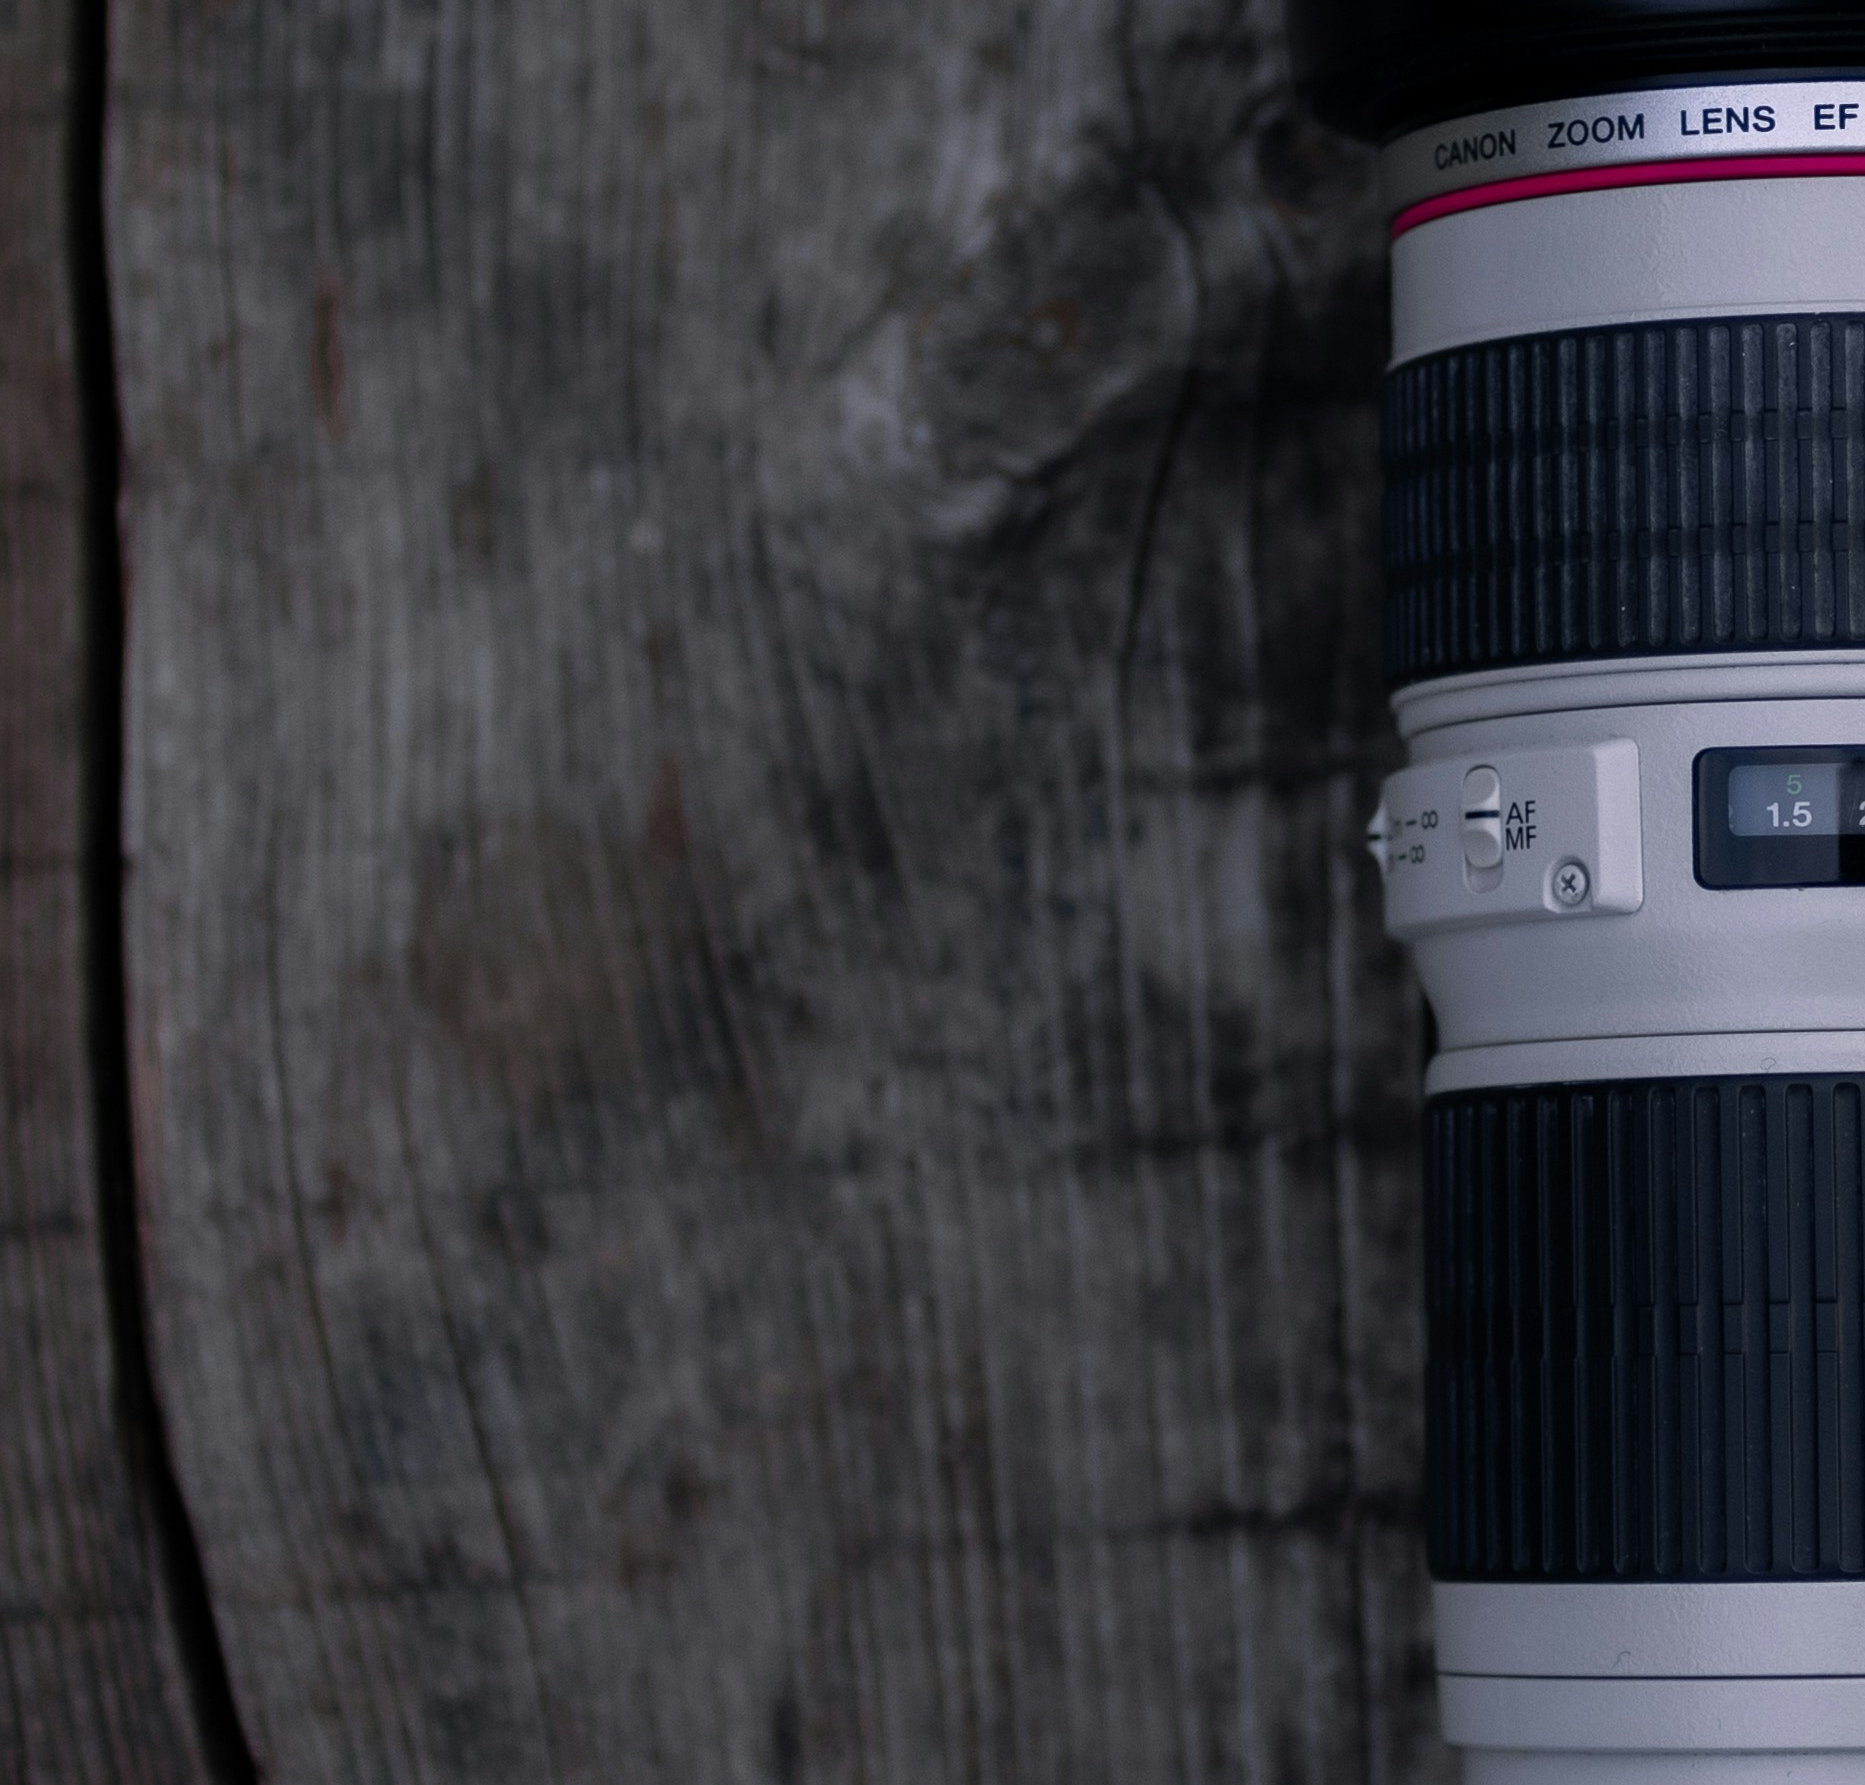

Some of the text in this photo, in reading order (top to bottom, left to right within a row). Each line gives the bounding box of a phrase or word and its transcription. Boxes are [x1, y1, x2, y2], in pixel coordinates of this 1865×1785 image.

[1435, 129, 1516, 171] CANON
[1547, 113, 1645, 149] ZOOM
[1680, 105, 1776, 136] LENS
[1813, 103, 1860, 131] EF
[1786, 774, 1802, 795] 5
[1505, 800, 1536, 826] AF
[1766, 801, 1812, 828] 1.5
[1505, 825, 1537, 851] MF
